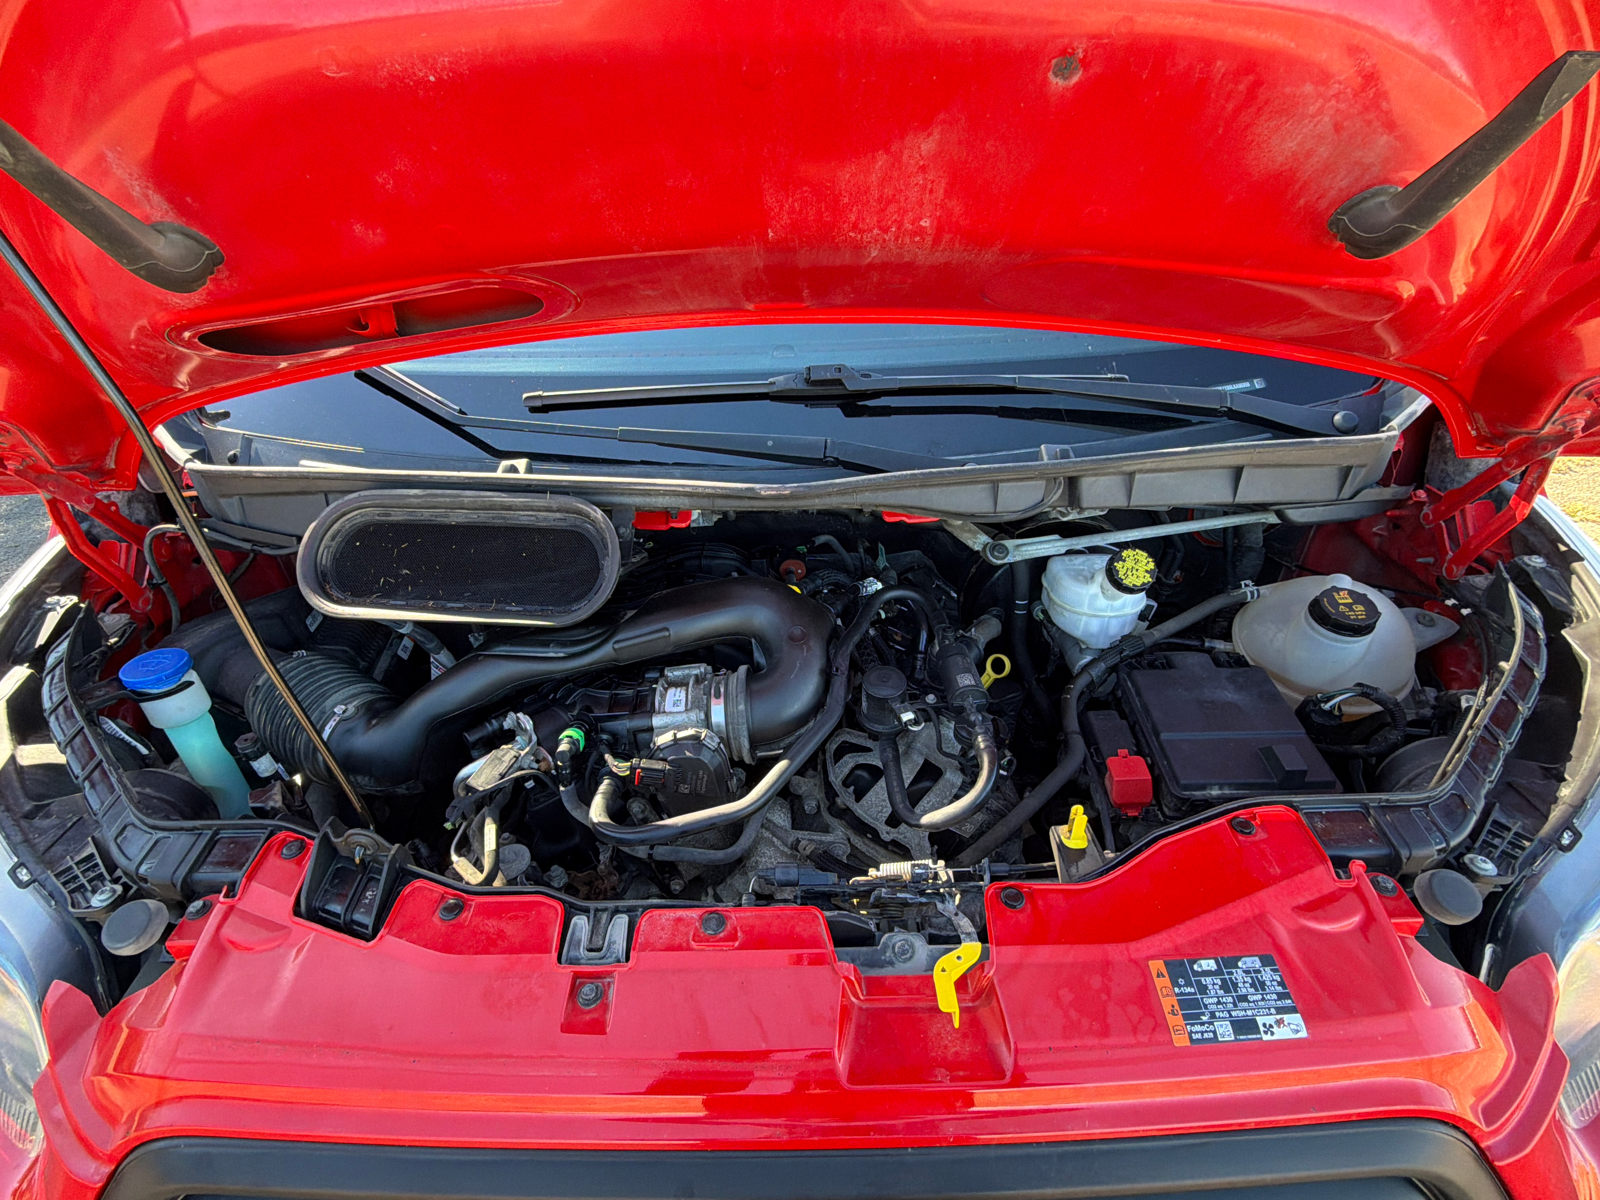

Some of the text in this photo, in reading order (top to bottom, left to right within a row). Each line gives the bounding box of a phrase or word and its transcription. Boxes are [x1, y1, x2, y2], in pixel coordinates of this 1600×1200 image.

[962, 823, 974, 832] 20
[1213, 977, 1222, 986] kg
[1243, 974, 1252, 984] kg
[1272, 972, 1281, 982] kg
[1203, 996, 1234, 1004] GWP 1430
[1215, 1008, 1277, 1018] PAG WSH-M1C231-B
[1186, 1024, 1215, 1032] FoMoCo
